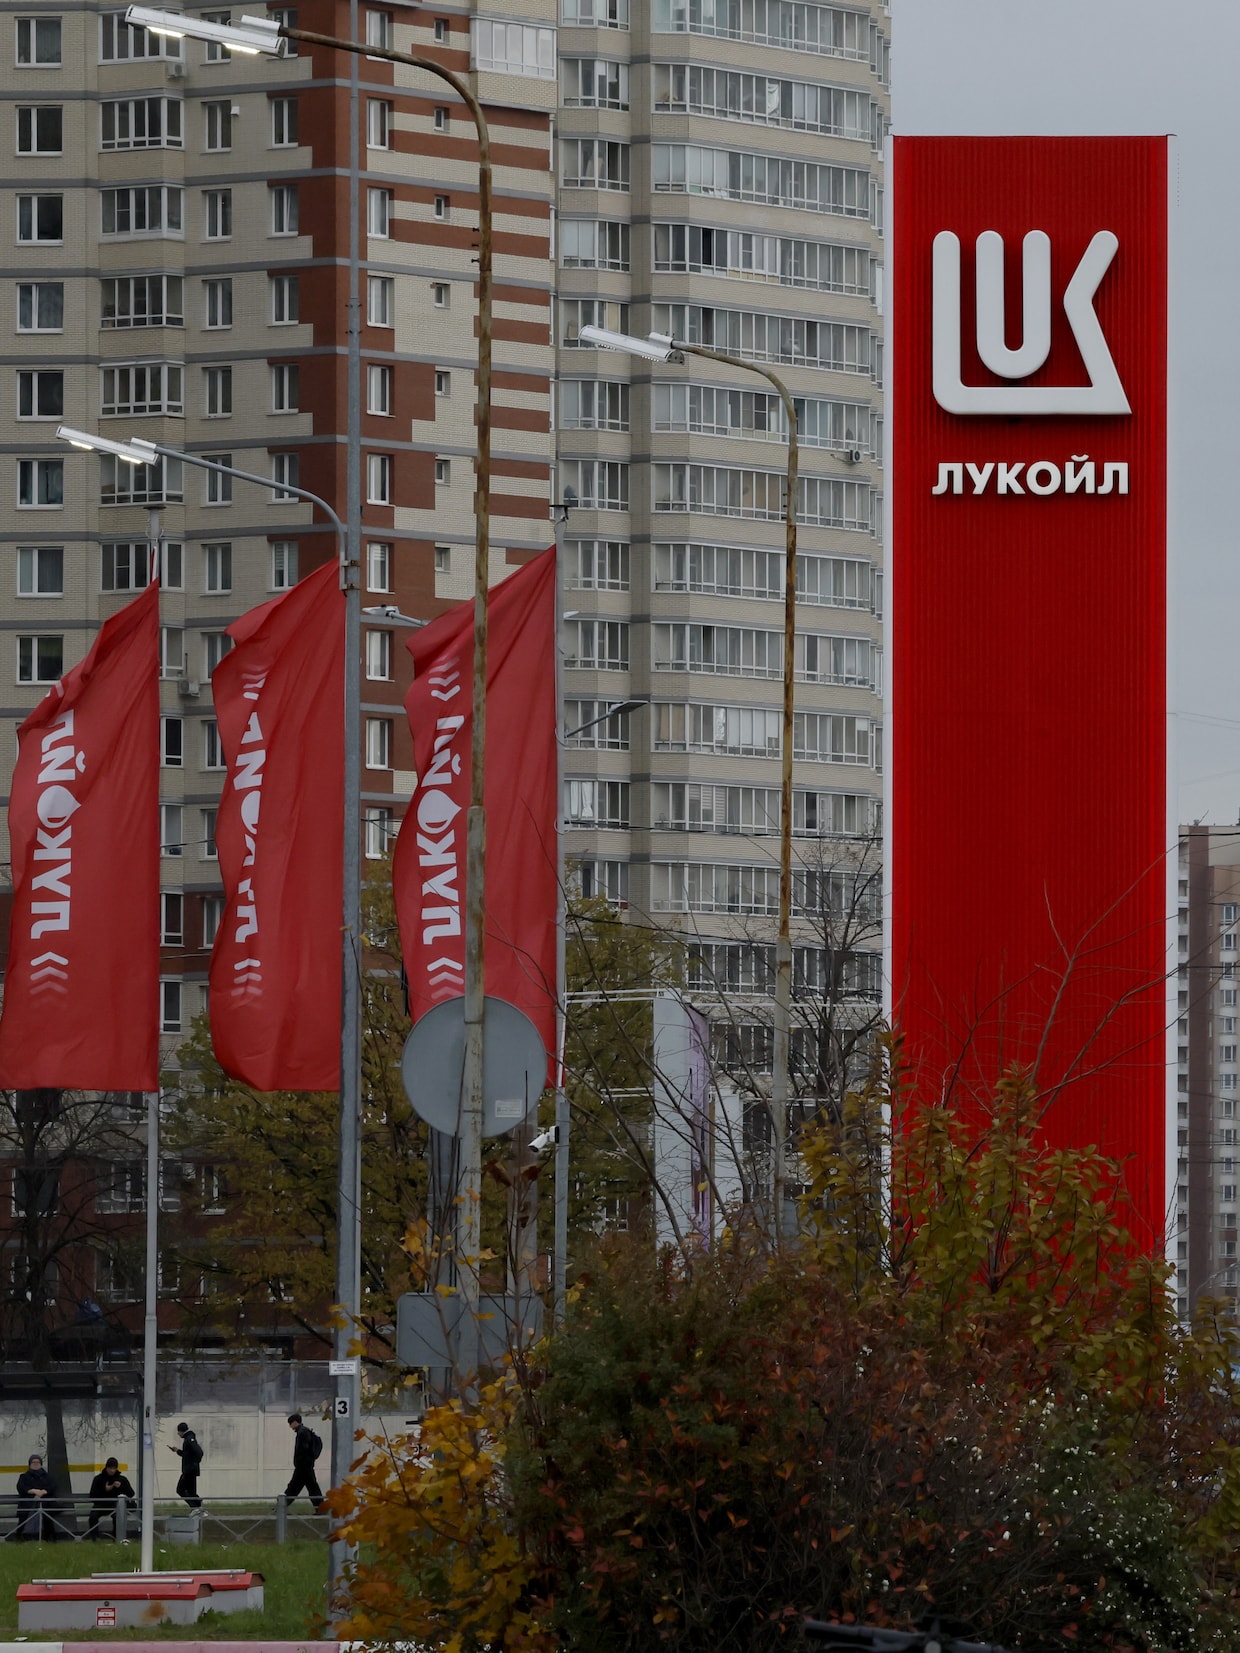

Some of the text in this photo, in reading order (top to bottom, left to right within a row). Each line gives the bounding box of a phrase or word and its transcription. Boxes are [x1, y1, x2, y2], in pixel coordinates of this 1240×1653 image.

[931, 453, 1130, 496] ЛУКОЙЛ
[30, 708, 87, 940] ЛУКОЙЛ
[416, 714, 466, 946] ЛУКОЙЛ
[337, 1400, 348, 1415] 3
